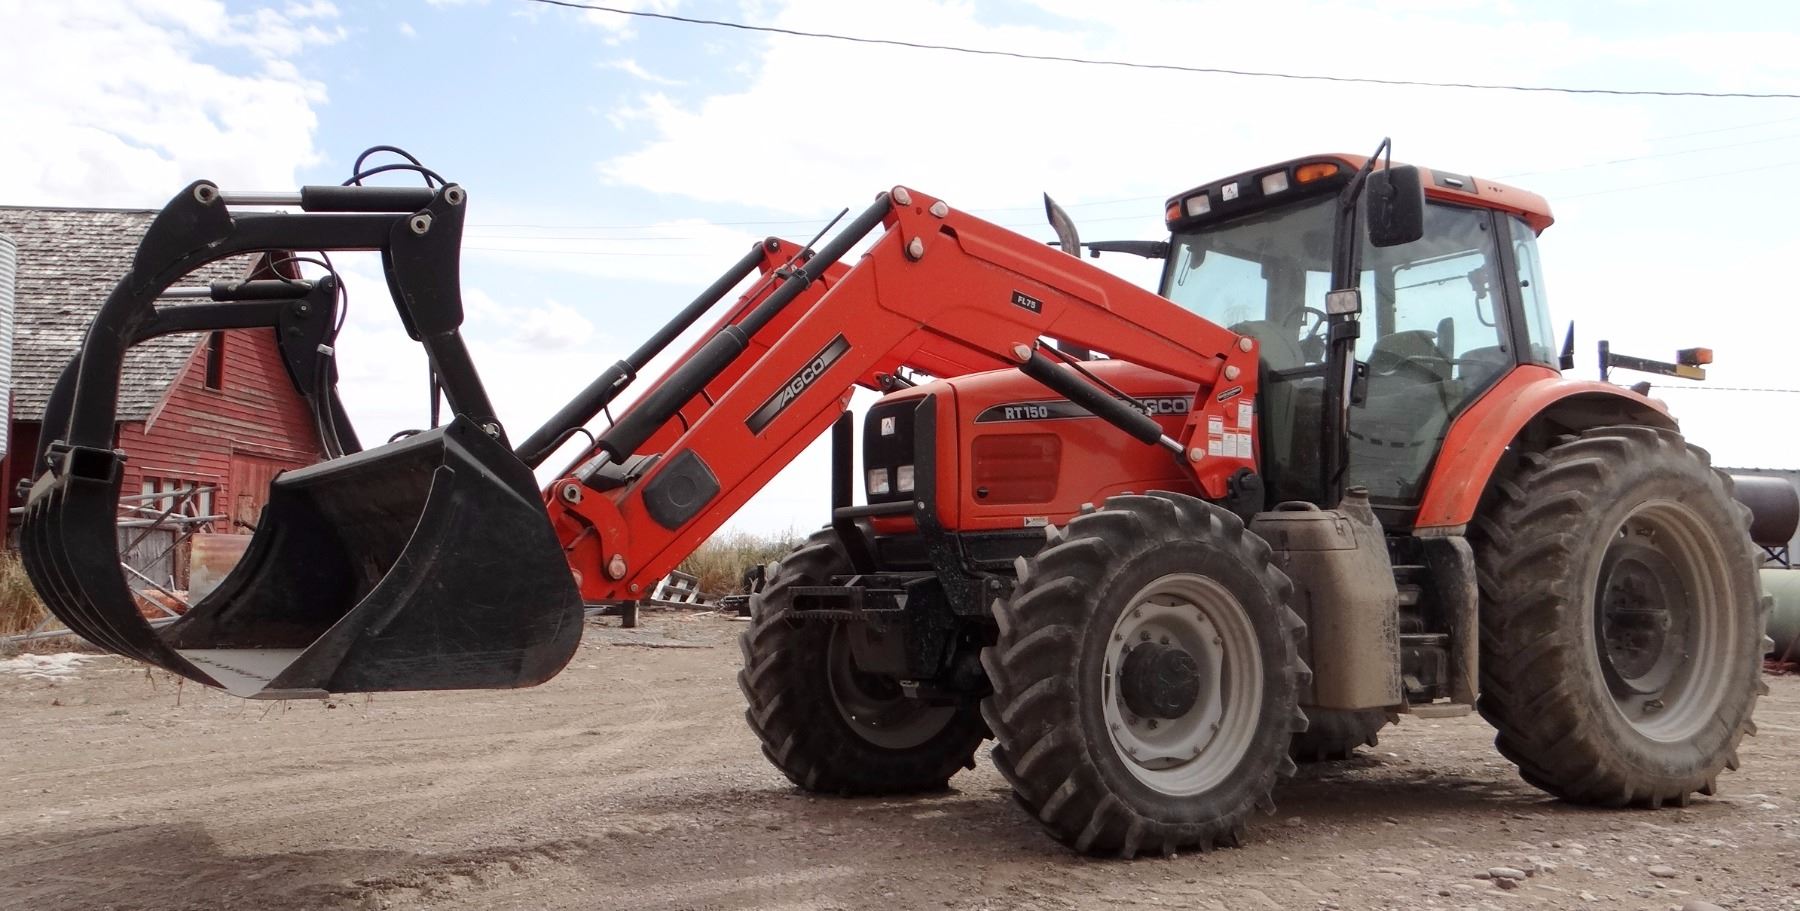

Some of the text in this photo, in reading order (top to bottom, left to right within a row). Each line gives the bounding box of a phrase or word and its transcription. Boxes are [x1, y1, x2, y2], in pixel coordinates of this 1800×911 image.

[1017, 295, 1036, 309] FL75
[780, 358, 825, 407] AGCO
[1004, 406, 1048, 419] RT150
[1136, 398, 1187, 414] GCO
